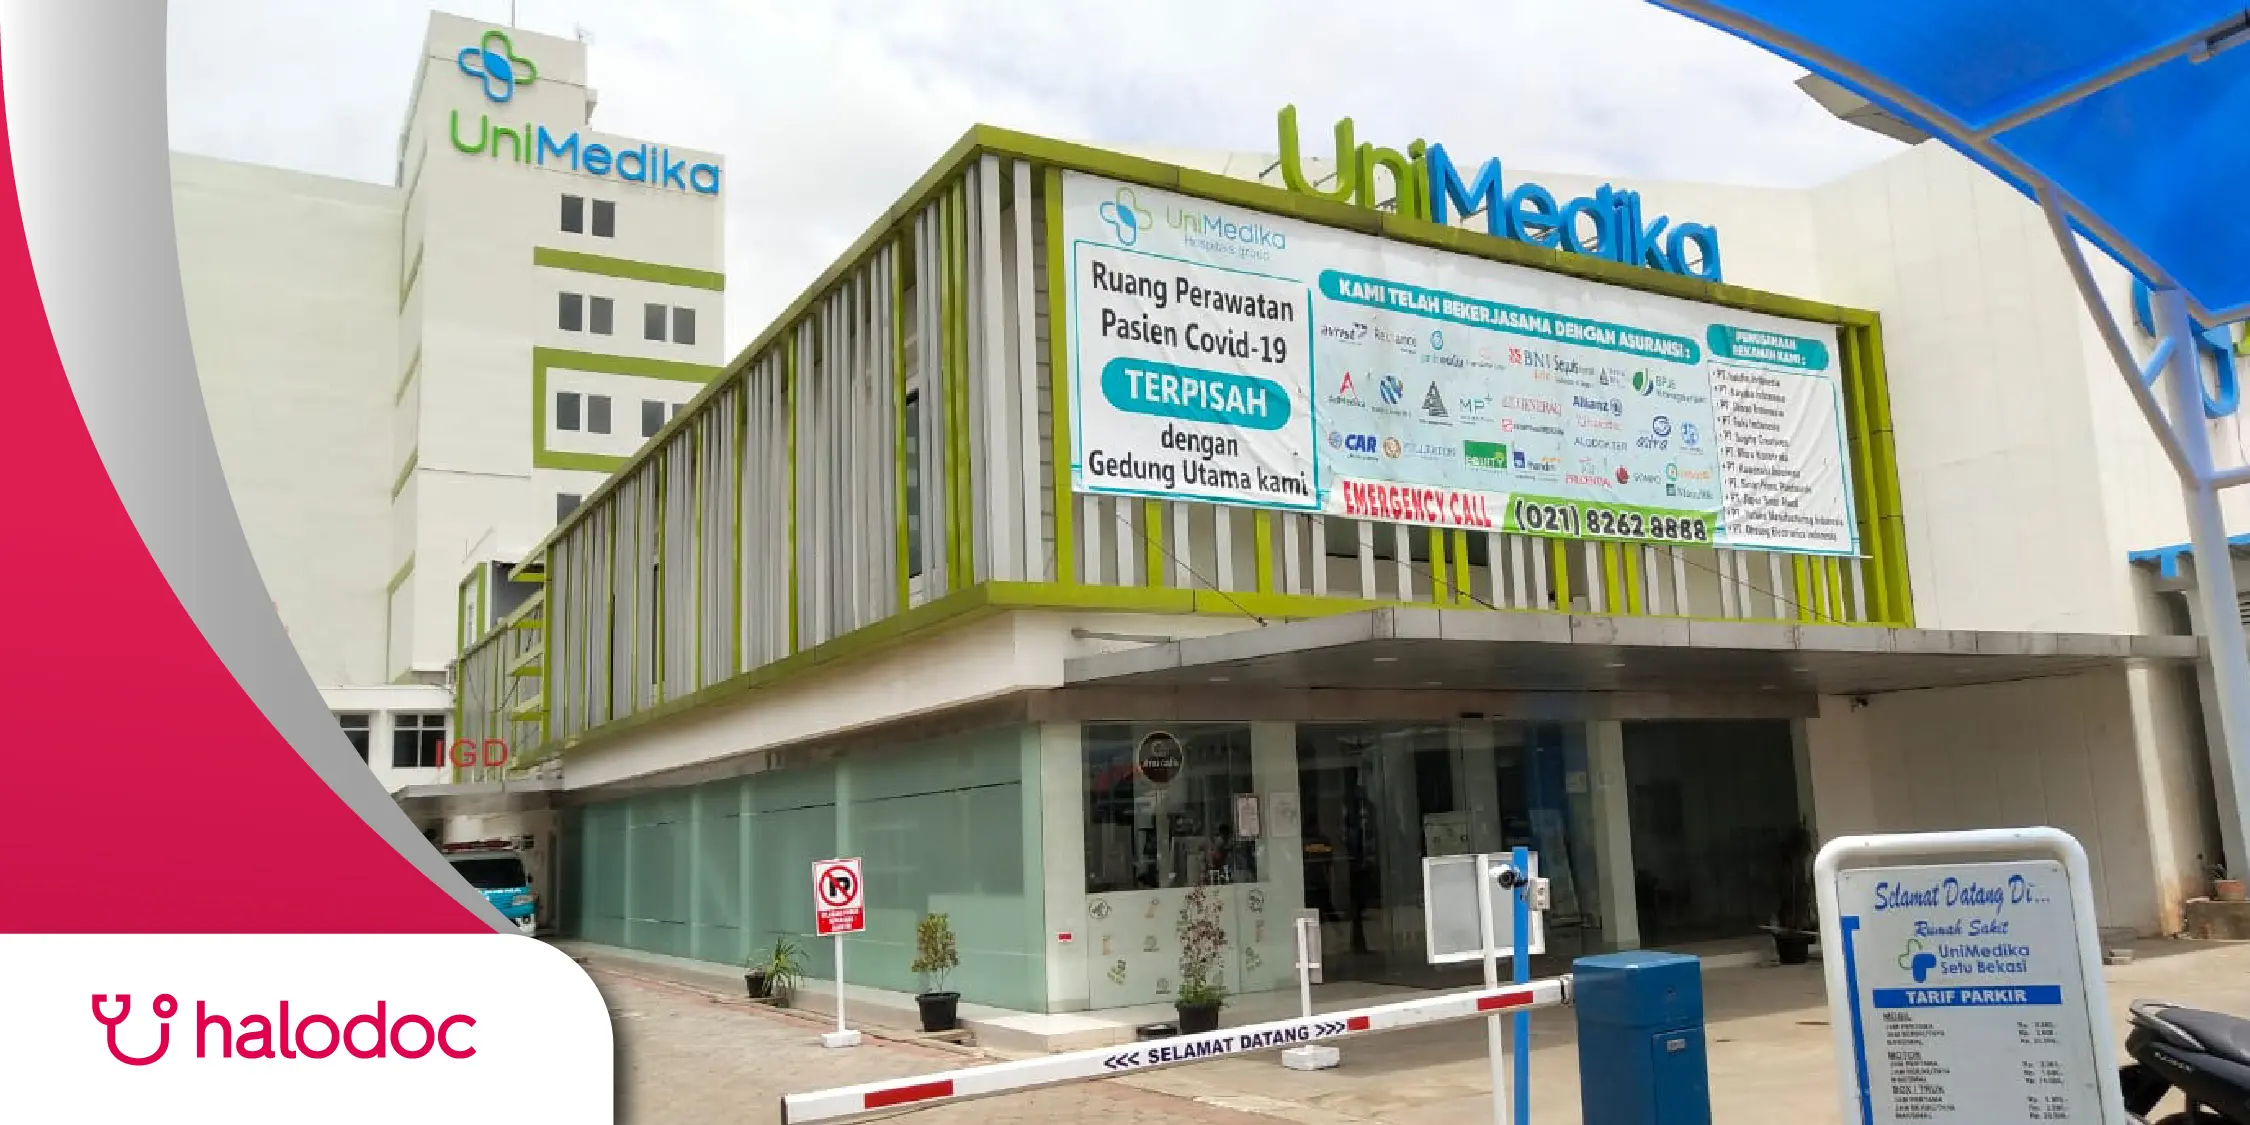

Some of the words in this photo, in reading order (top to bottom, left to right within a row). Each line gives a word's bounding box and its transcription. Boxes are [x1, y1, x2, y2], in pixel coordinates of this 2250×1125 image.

[450, 108, 722, 195] UniMedika
[1277, 104, 1723, 283] UniMedika
[1167, 203, 1287, 250] UniMedika
[1092, 260, 1168, 308] Ruang
[1177, 276, 1295, 322] Perawatan
[1101, 307, 1177, 347] Pasien
[1185, 323, 1288, 364] Covid-19
[1339, 278, 1386, 303] KAMI
[1388, 287, 1440, 314] TELAH
[1442, 299, 1552, 335] BEKERJASAMA
[1555, 319, 1616, 345] DENGAN
[1619, 331, 1684, 357] ASURANSI
[1125, 368, 1268, 418] TERPISAH
[1161, 422, 1238, 461] dengan
[1344, 434, 1378, 454] CAR
[1089, 450, 1175, 489] Gedung
[1183, 459, 1251, 490] Utama
[1257, 465, 1309, 496] kami
[1343, 480, 1445, 523] EMERGENCY
[1449, 491, 1492, 528] CALL
[1514, 497, 1581, 537] (021)
[1586, 509, 1645, 539] 8262
[1649, 515, 1708, 543] 8888
[435, 738, 509, 769] IGD
[1873, 882, 1940, 911] Selamat
[1942, 876, 2004, 914] Datang
[1913, 920, 1962, 938] Rumah
[1968, 918, 2009, 937] Sakit
[1938, 943, 2030, 959] UniMedika
[1940, 960, 1973, 975] Setu
[1977, 958, 2028, 974] Bekasi
[1905, 989, 1956, 1005] TARIF
[1961, 989, 2028, 1004] PARKIR
[1148, 1037, 1234, 1064] SELAMAT
[1241, 1025, 1310, 1049] DATANG
